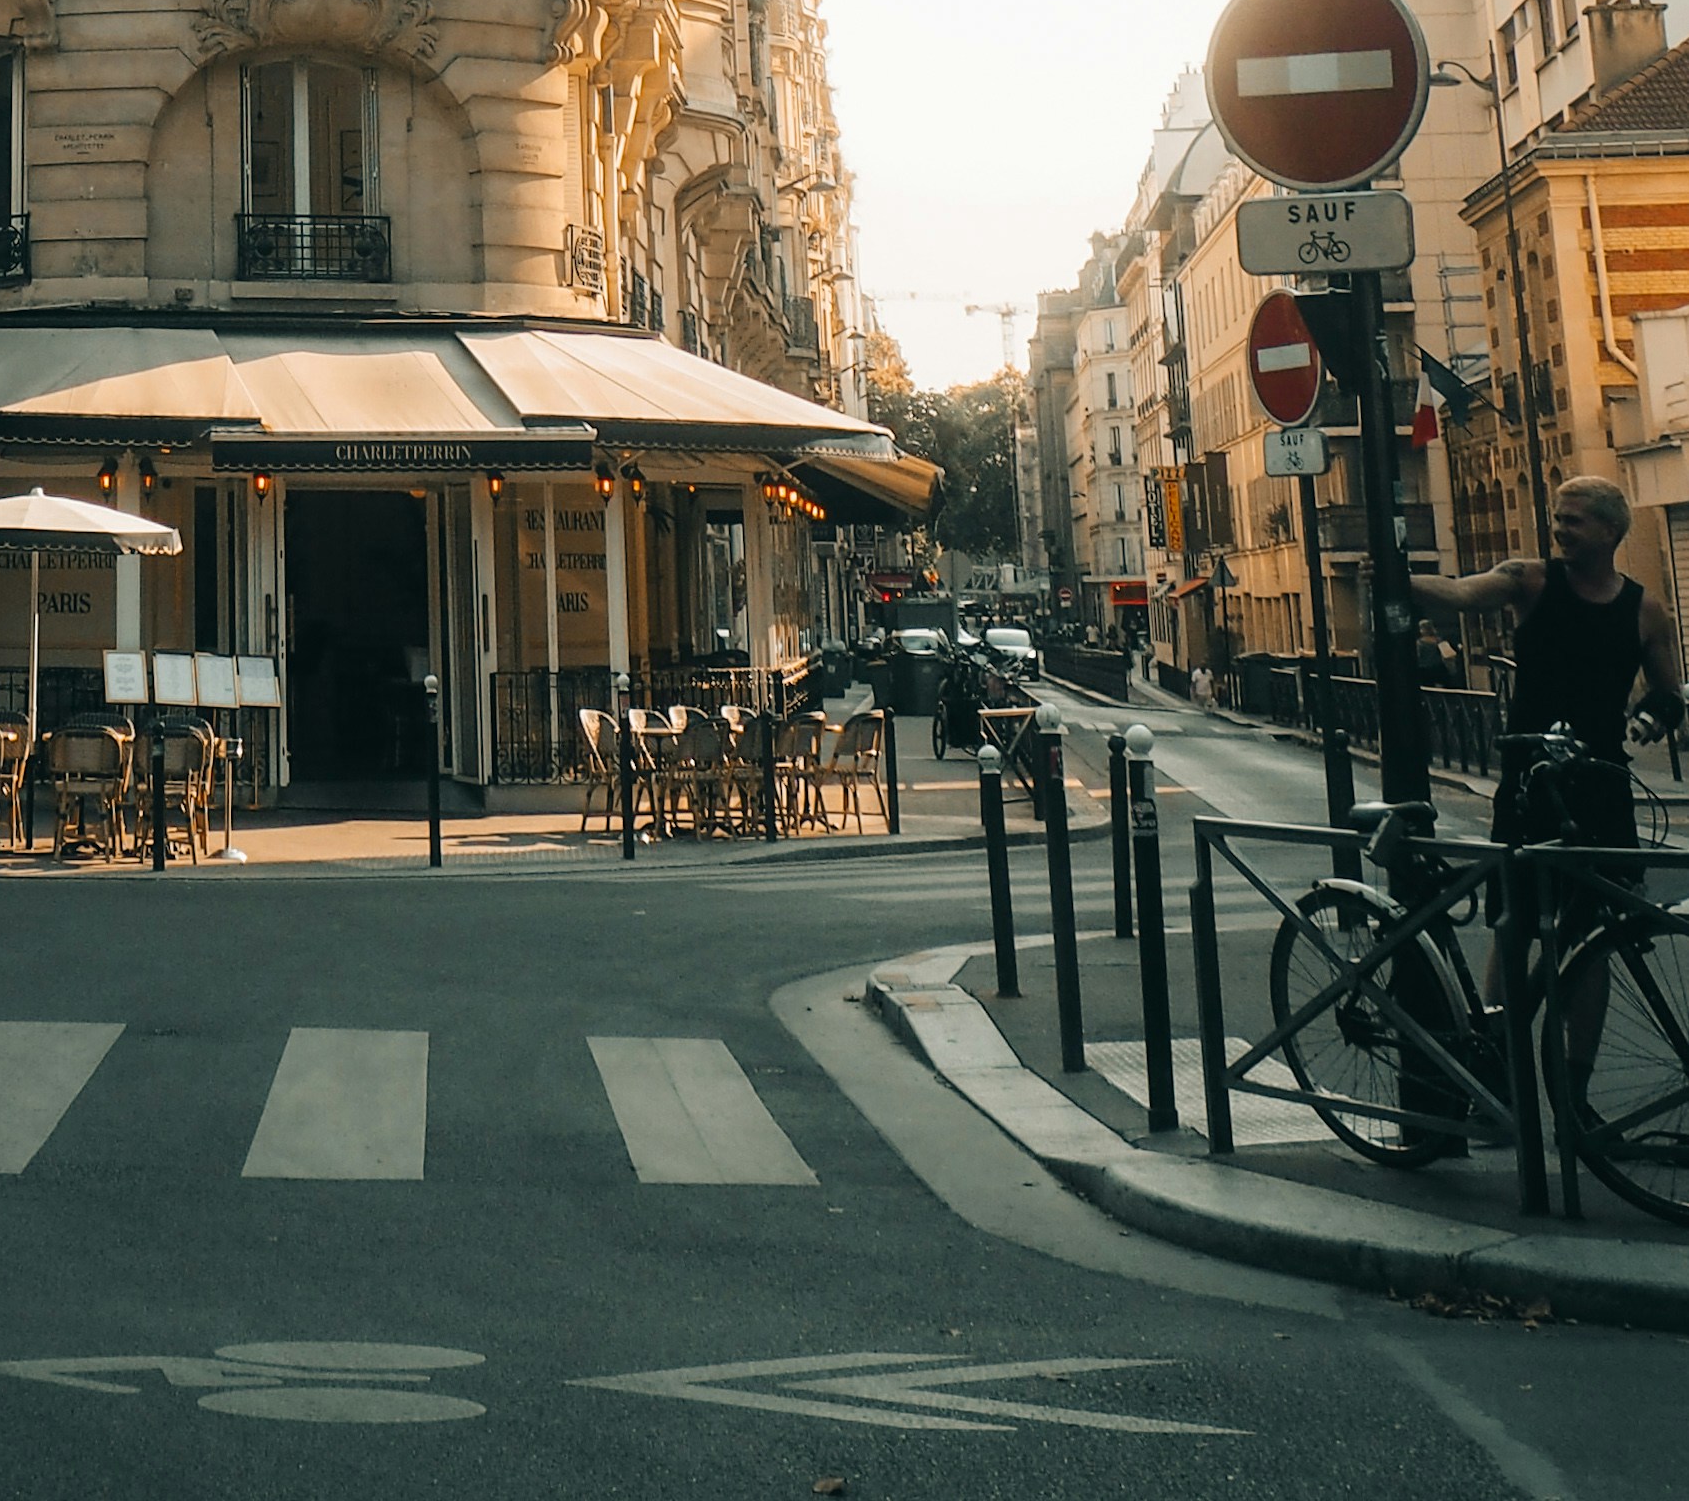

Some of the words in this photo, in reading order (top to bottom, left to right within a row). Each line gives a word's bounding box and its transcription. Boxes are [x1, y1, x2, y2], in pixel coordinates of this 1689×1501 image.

[1288, 201, 1356, 223] SAUF
[1280, 433, 1304, 446] SAUF
[335, 444, 471, 460] CHARLETPERRIN
[1151, 468, 1186, 479] PIZZ
[1146, 480, 1159, 537] HOTEL
[38, 592, 91, 613] PARIS
[557, 592, 589, 612] ARIS
